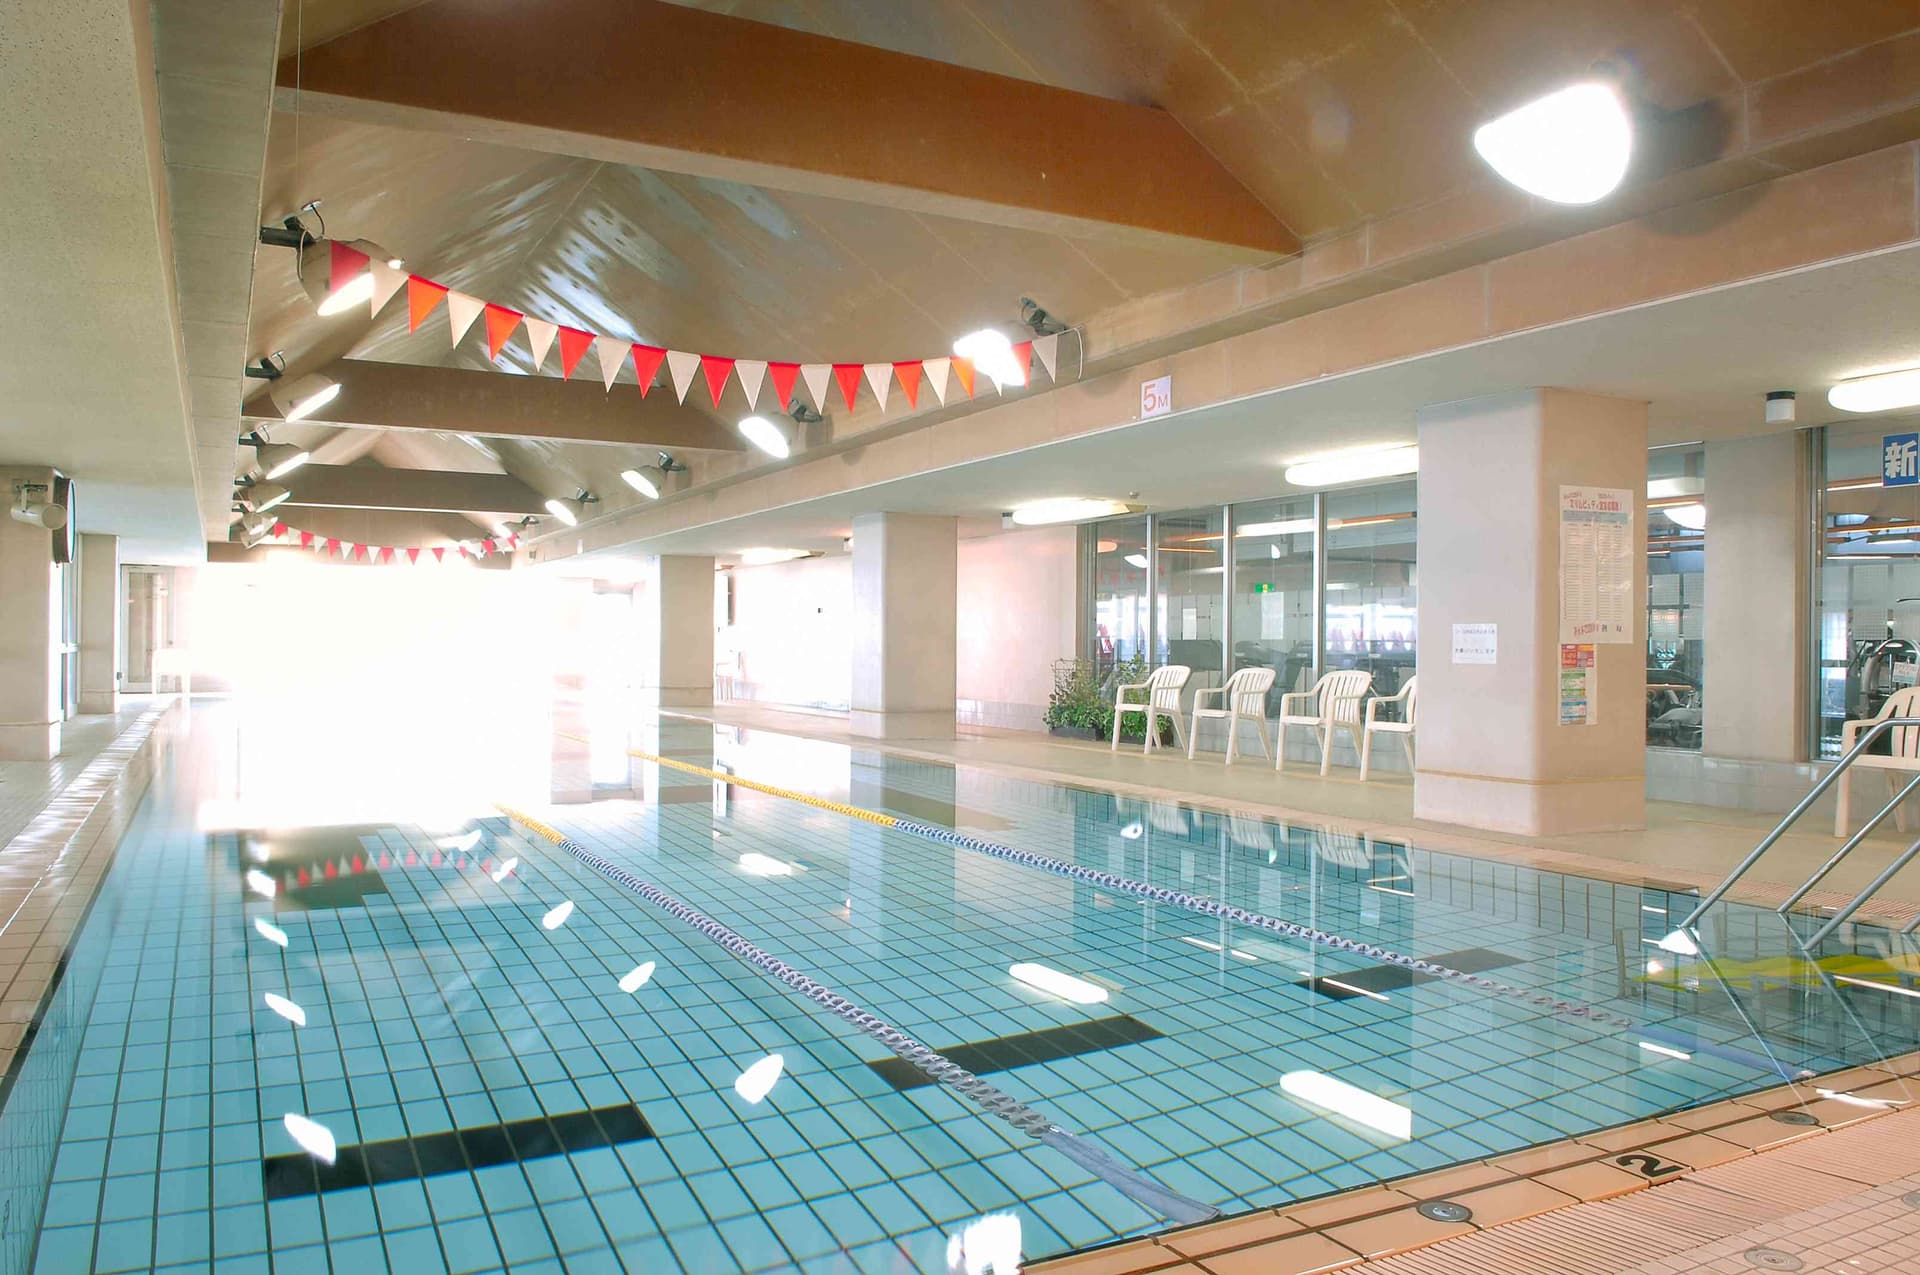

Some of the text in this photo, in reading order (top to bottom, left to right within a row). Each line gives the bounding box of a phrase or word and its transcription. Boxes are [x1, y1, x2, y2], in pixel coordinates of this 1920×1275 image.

[1143, 383, 1168, 412] 5M
[1885, 440, 1917, 478] 新
[1615, 1155, 1684, 1178] 2
